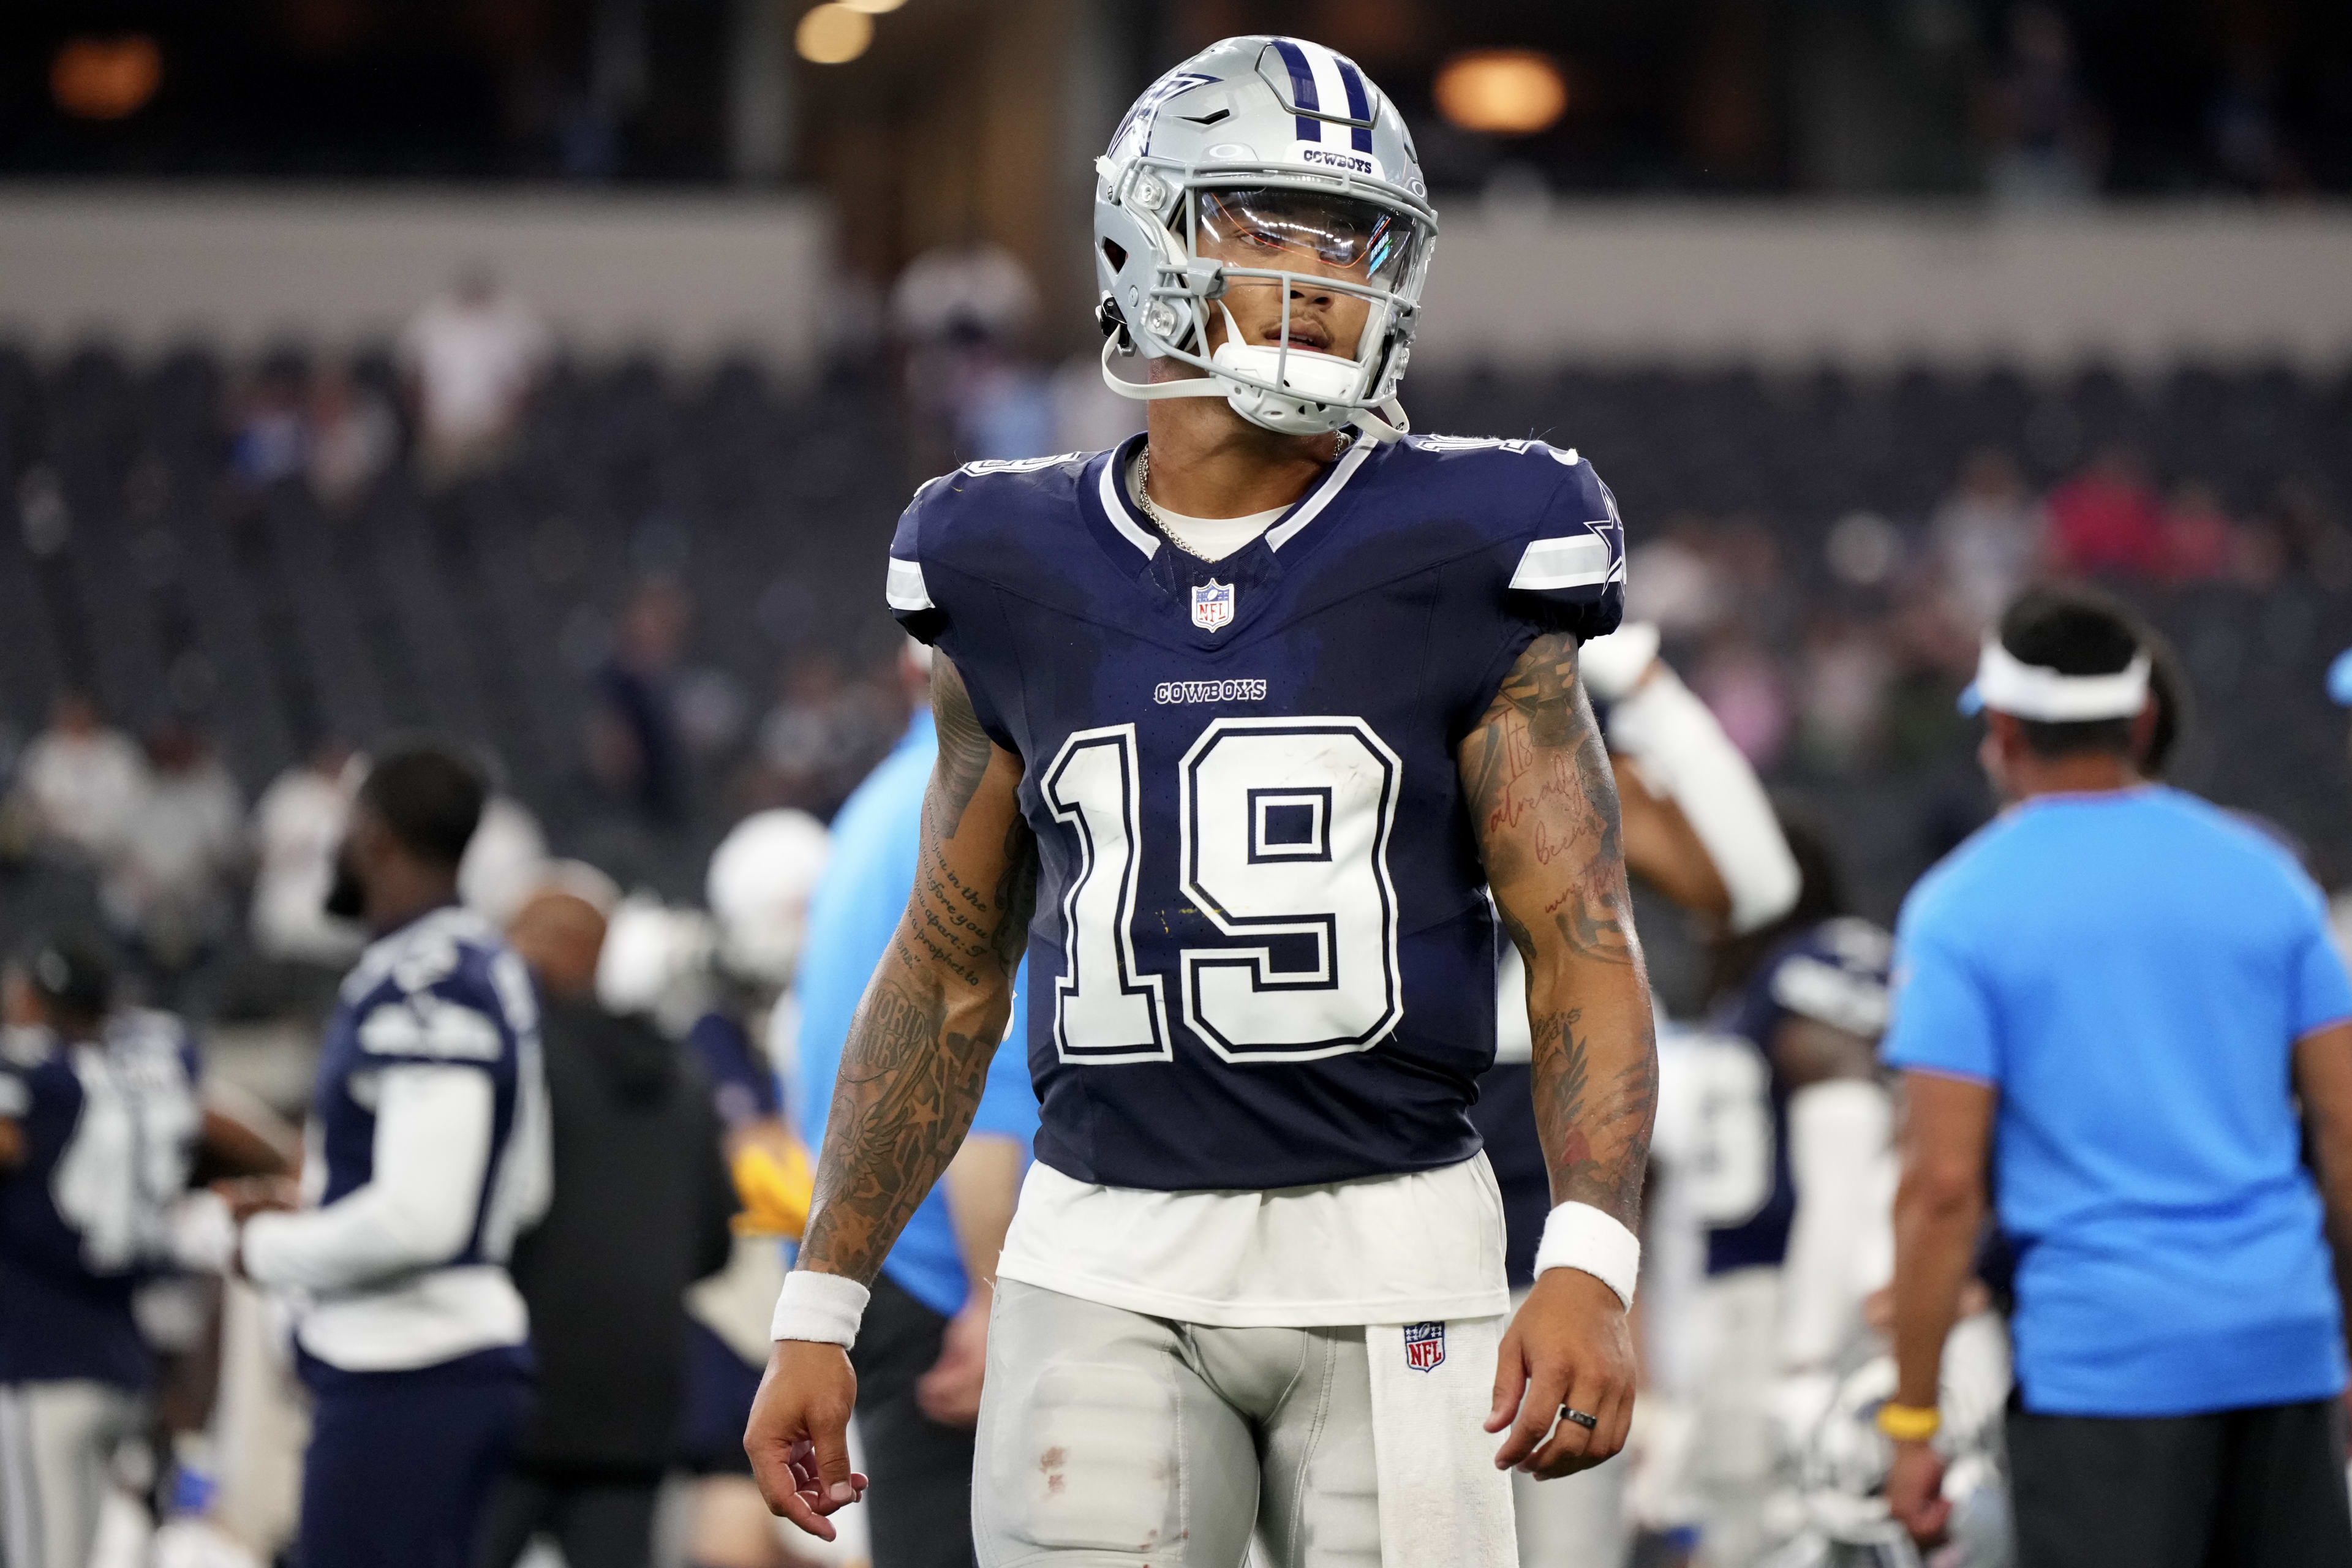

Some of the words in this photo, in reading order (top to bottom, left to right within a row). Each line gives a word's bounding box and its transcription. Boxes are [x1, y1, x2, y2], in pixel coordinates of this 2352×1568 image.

[1303, 149, 1372, 175] COWBOYS
[1199, 603, 1226, 623] NFL
[1154, 679, 1267, 705] COWBOYS
[961, 886, 987, 912] the
[1041, 716, 1404, 1065] 19
[949, 914, 989, 940] you
[914, 928, 965, 975] prophet
[965, 970, 979, 986] to
[1408, 1340, 1442, 1368] NFL
